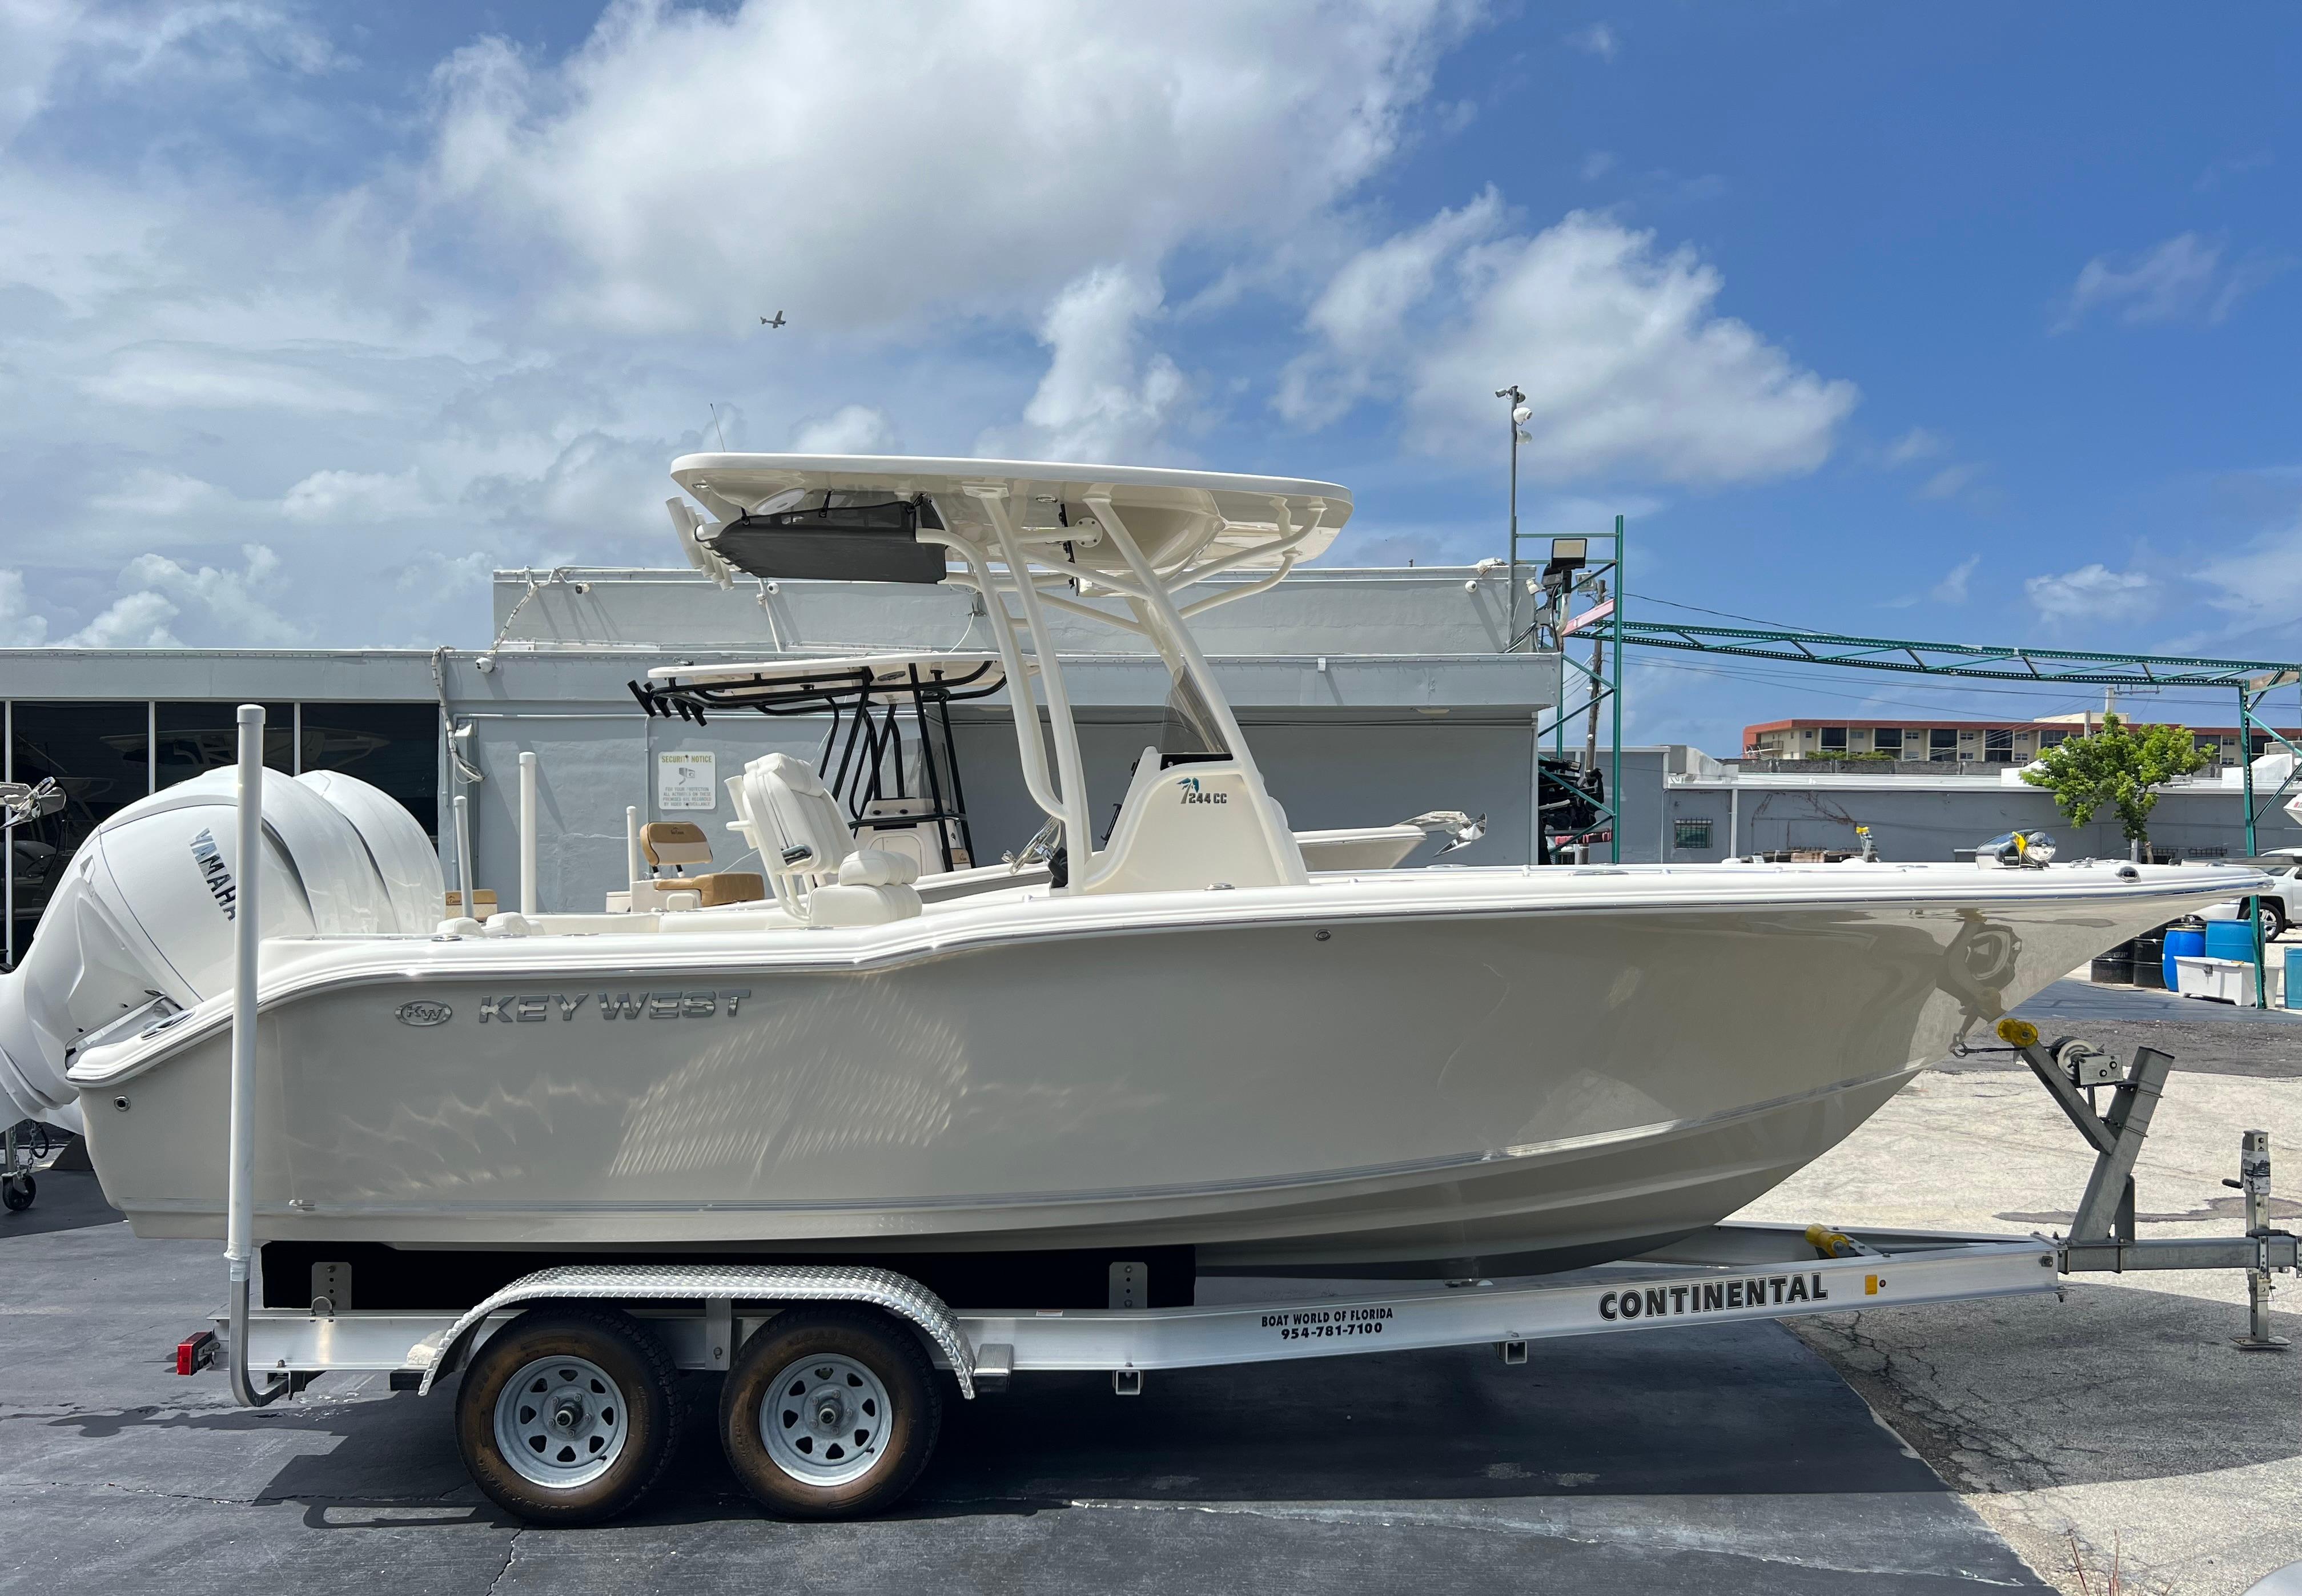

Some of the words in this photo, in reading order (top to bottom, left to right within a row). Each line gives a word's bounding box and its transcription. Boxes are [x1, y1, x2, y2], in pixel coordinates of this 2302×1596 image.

[1188, 793, 1211, 804] 244
[1213, 793, 1227, 804] CC
[478, 992, 589, 1023] KEY
[597, 989, 752, 1020] WEST
[1598, 1272, 1828, 1321] CONTINENTAL
[1262, 1314, 1289, 1327] BOAT
[1293, 1313, 1329, 1325] WORLD
[1334, 1310, 1347, 1322] OF
[1351, 1308, 1393, 1321] FLORIDA
[1281, 1322, 1383, 1340] 954-781-7100
